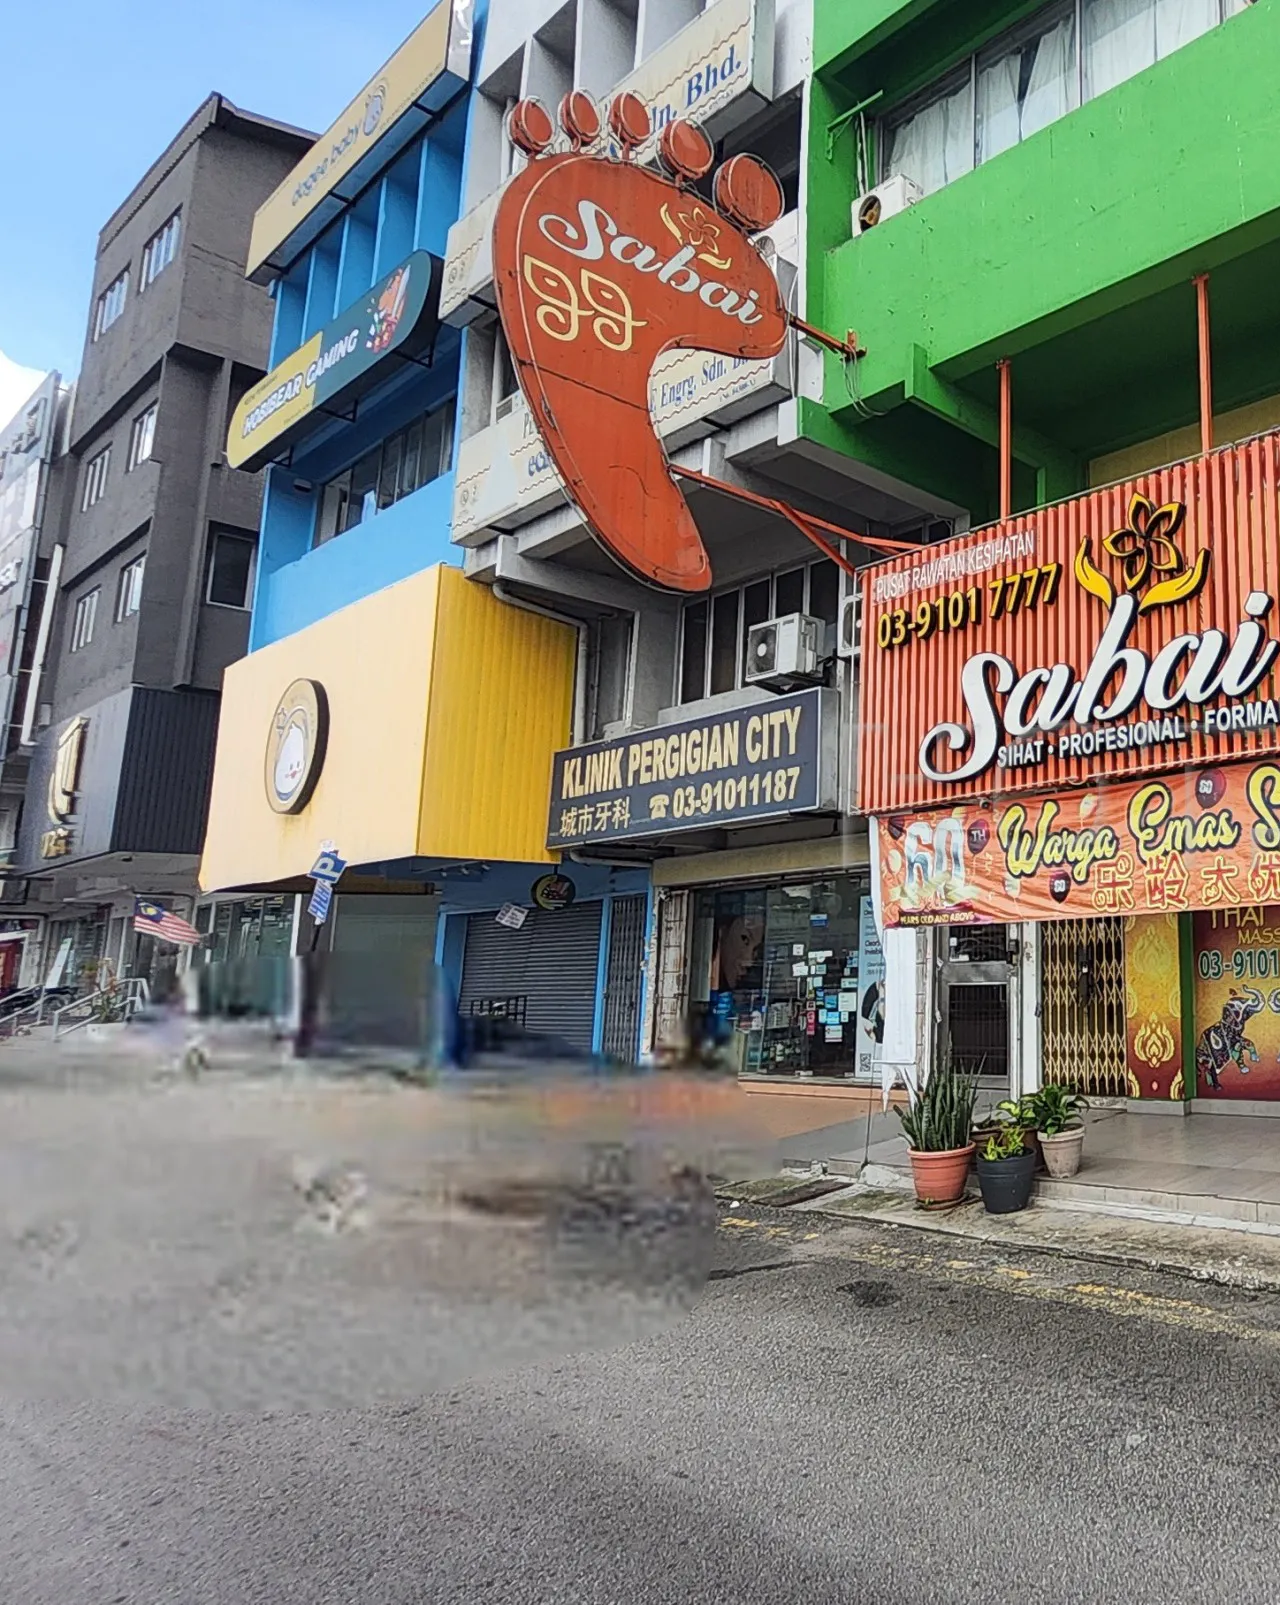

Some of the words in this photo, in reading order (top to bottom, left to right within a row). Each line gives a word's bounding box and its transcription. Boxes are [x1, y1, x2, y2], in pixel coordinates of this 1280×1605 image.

[685, 44, 741, 110] Bhd.
[538, 200, 767, 326] Sabai
[304, 329, 361, 389] GAMING
[701, 355, 727, 386] Sdn.
[876, 569, 910, 602] PUSAT
[911, 551, 966, 591] RAWATAN
[966, 530, 1034, 573] KESIHATAN
[877, 586, 980, 649] 03-9101
[988, 562, 1060, 620] 7777
[918, 591, 1280, 783] Sabai
[561, 746, 625, 800] KLINIK
[627, 719, 740, 787] PERGIGIAN
[745, 706, 802, 765] CITY
[996, 740, 1046, 769] SIHAT
[1059, 718, 1188, 758] PROFESIONAL
[560, 796, 631, 838] 城市牙科
[672, 766, 801, 818] 03-91011187
[904, 818, 965, 894] 60
[971, 828, 987, 842] TH
[997, 798, 1120, 886] Warga
[1127, 780, 1241, 864] Emas
[312, 856, 342, 880] P
[1207, 905, 1265, 930] THAI
[1199, 947, 1280, 980] 03-9101
